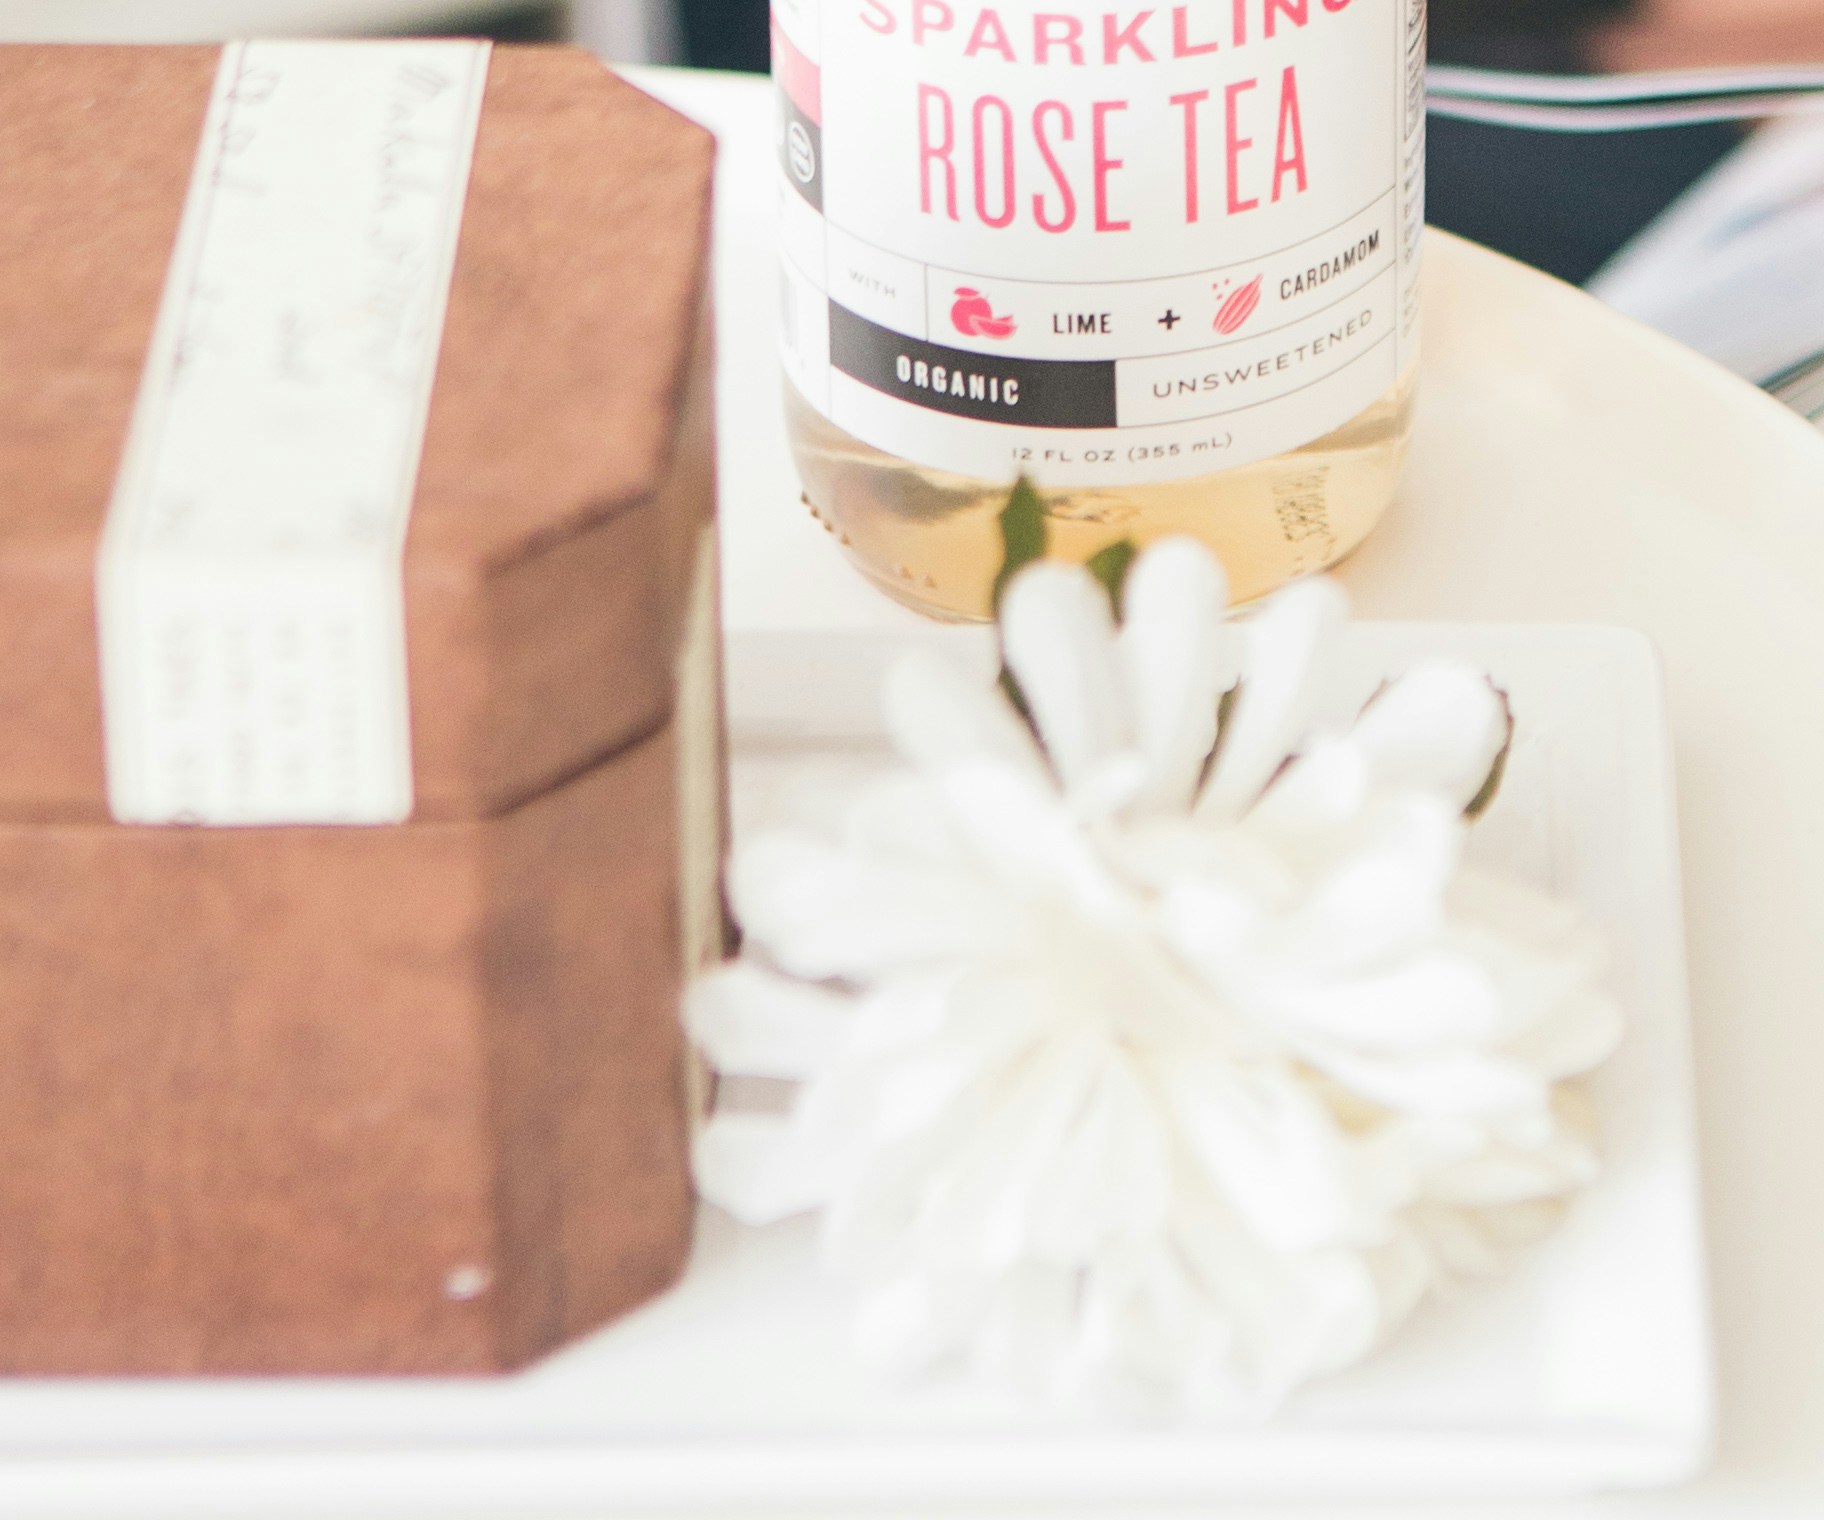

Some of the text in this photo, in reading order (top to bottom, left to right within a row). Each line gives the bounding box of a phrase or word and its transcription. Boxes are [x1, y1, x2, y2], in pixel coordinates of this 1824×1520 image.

[917, 82, 1131, 233] ROSE
[1169, 65, 1308, 223] TEA
[848, 268, 896, 299] WITH
[1053, 313, 1112, 334] LIME
[1279, 230, 1380, 300] CARDAMOM
[895, 309, 1373, 406] ORGANIC UNSWEETENED
[1012, 432, 1233, 463] 12 FL OZ (355 mL)
